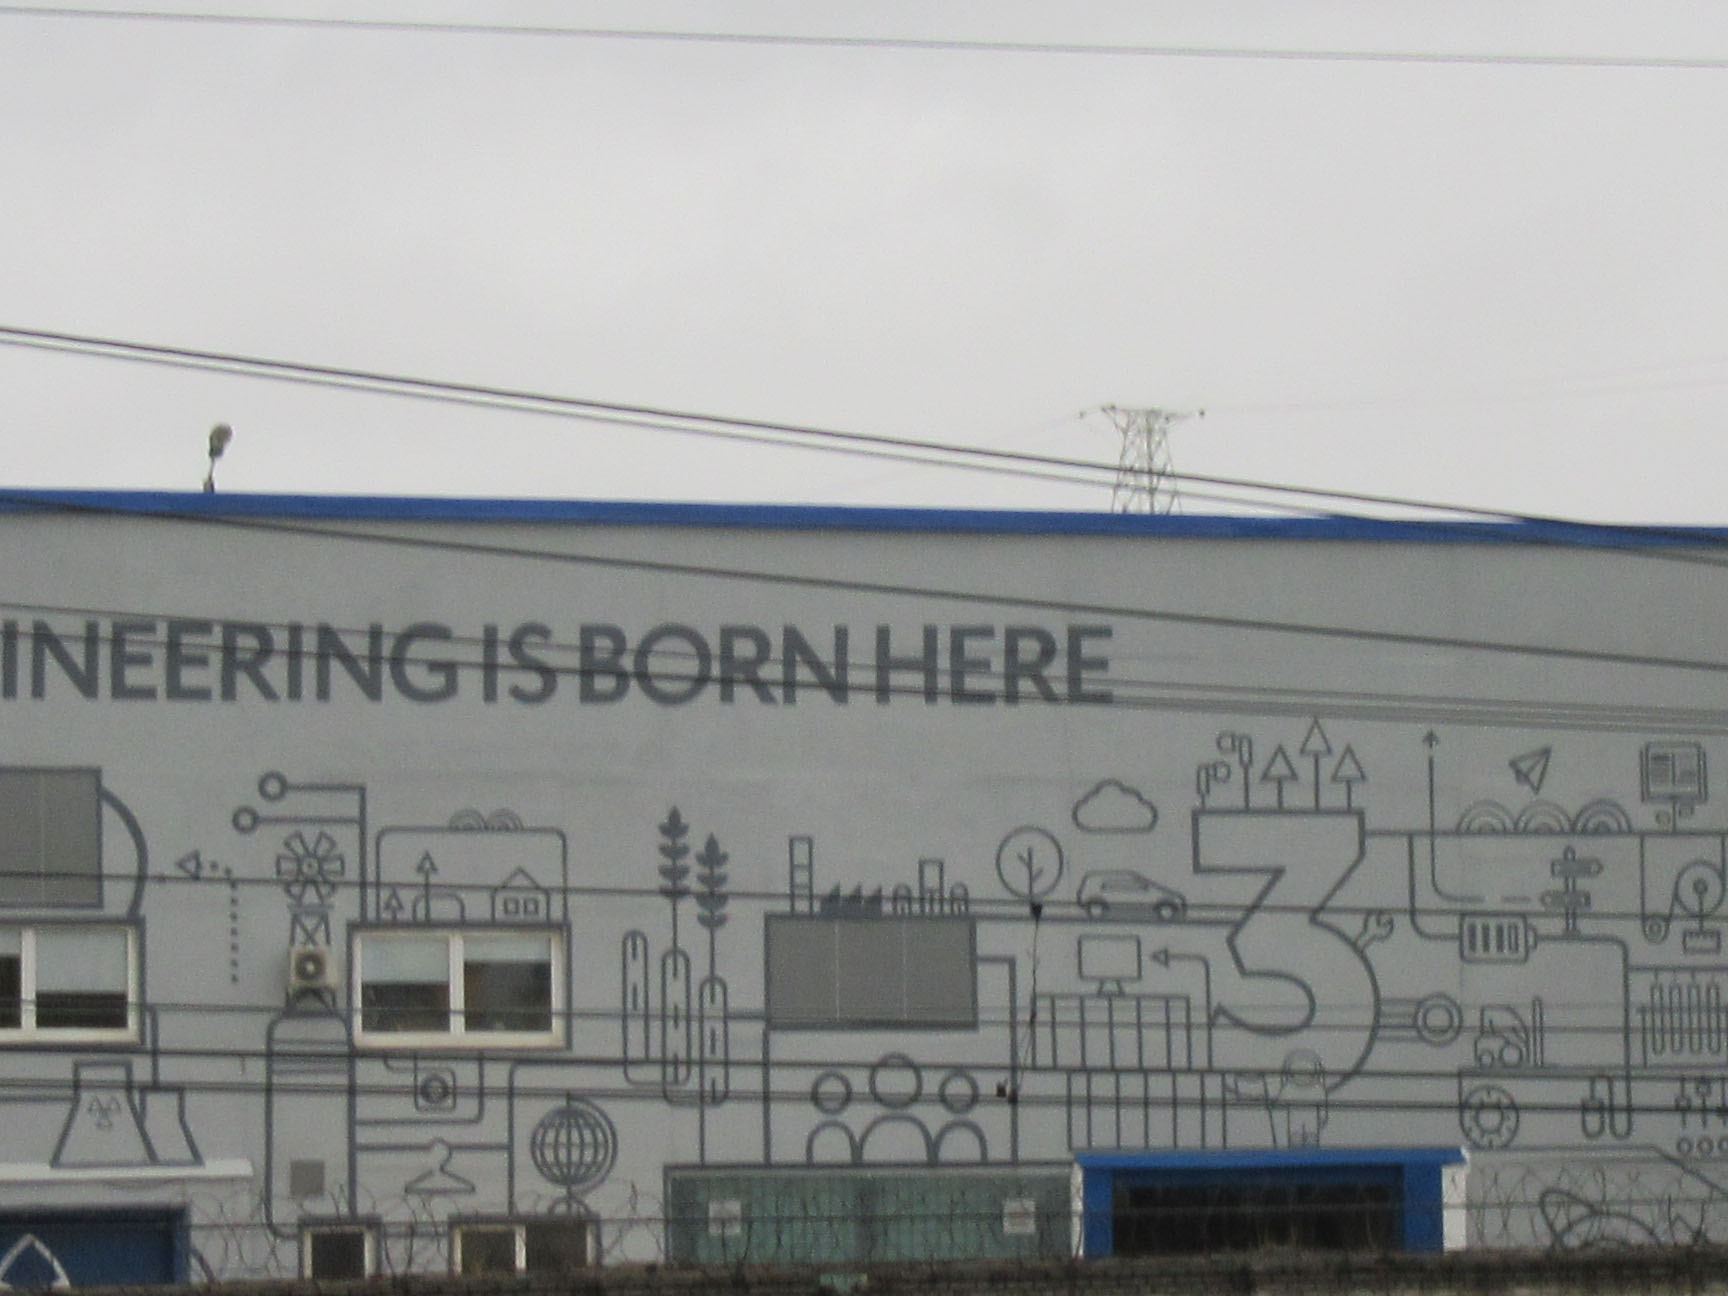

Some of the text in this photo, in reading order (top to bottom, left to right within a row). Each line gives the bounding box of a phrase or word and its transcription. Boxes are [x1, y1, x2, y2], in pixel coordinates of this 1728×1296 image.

[481, 621, 559, 706] IS
[579, 622, 850, 707] BORN
[874, 623, 1114, 709] HERE
